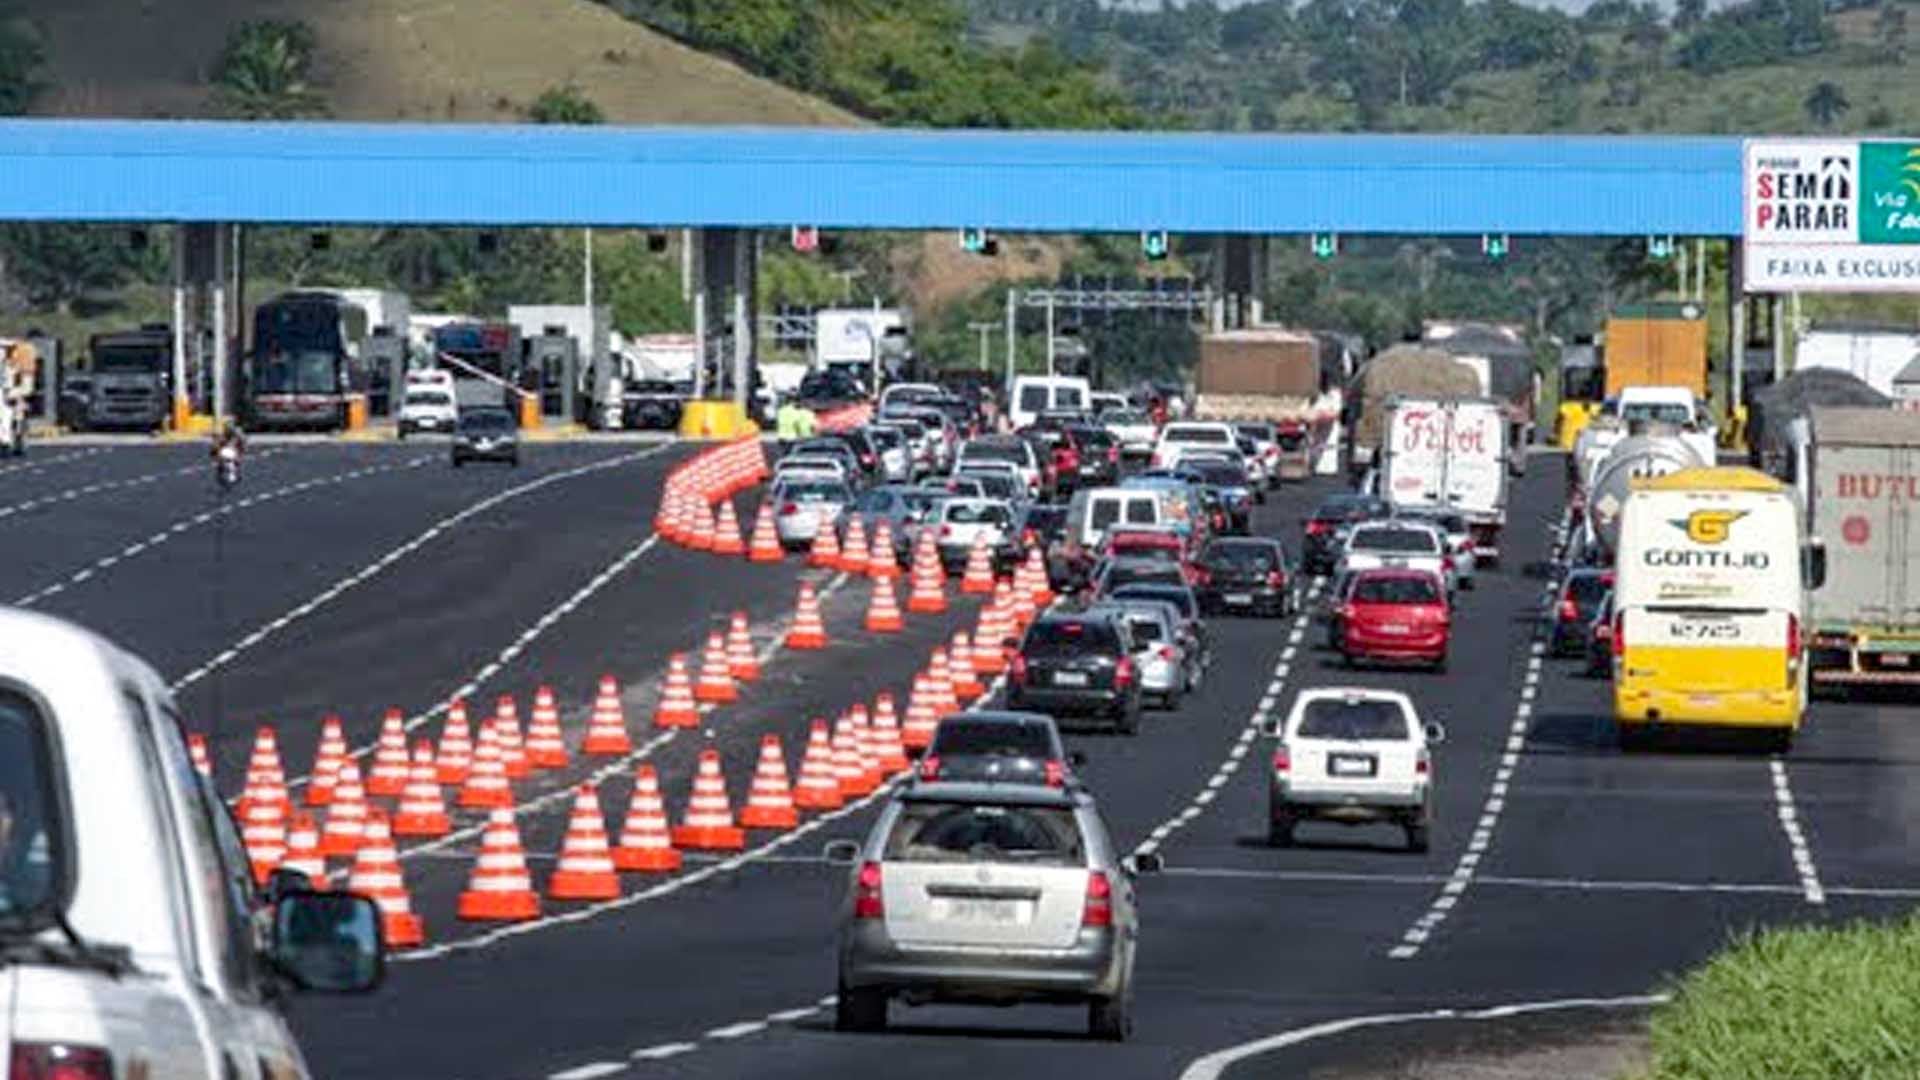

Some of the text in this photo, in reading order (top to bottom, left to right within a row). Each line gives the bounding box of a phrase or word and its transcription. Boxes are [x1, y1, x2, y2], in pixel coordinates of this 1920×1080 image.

[1757, 173, 1817, 200] SEM
[1757, 203, 1848, 230] PARAR
[1767, 259, 1827, 277] FAIXA
[1644, 547, 1770, 569] GONTIJO
